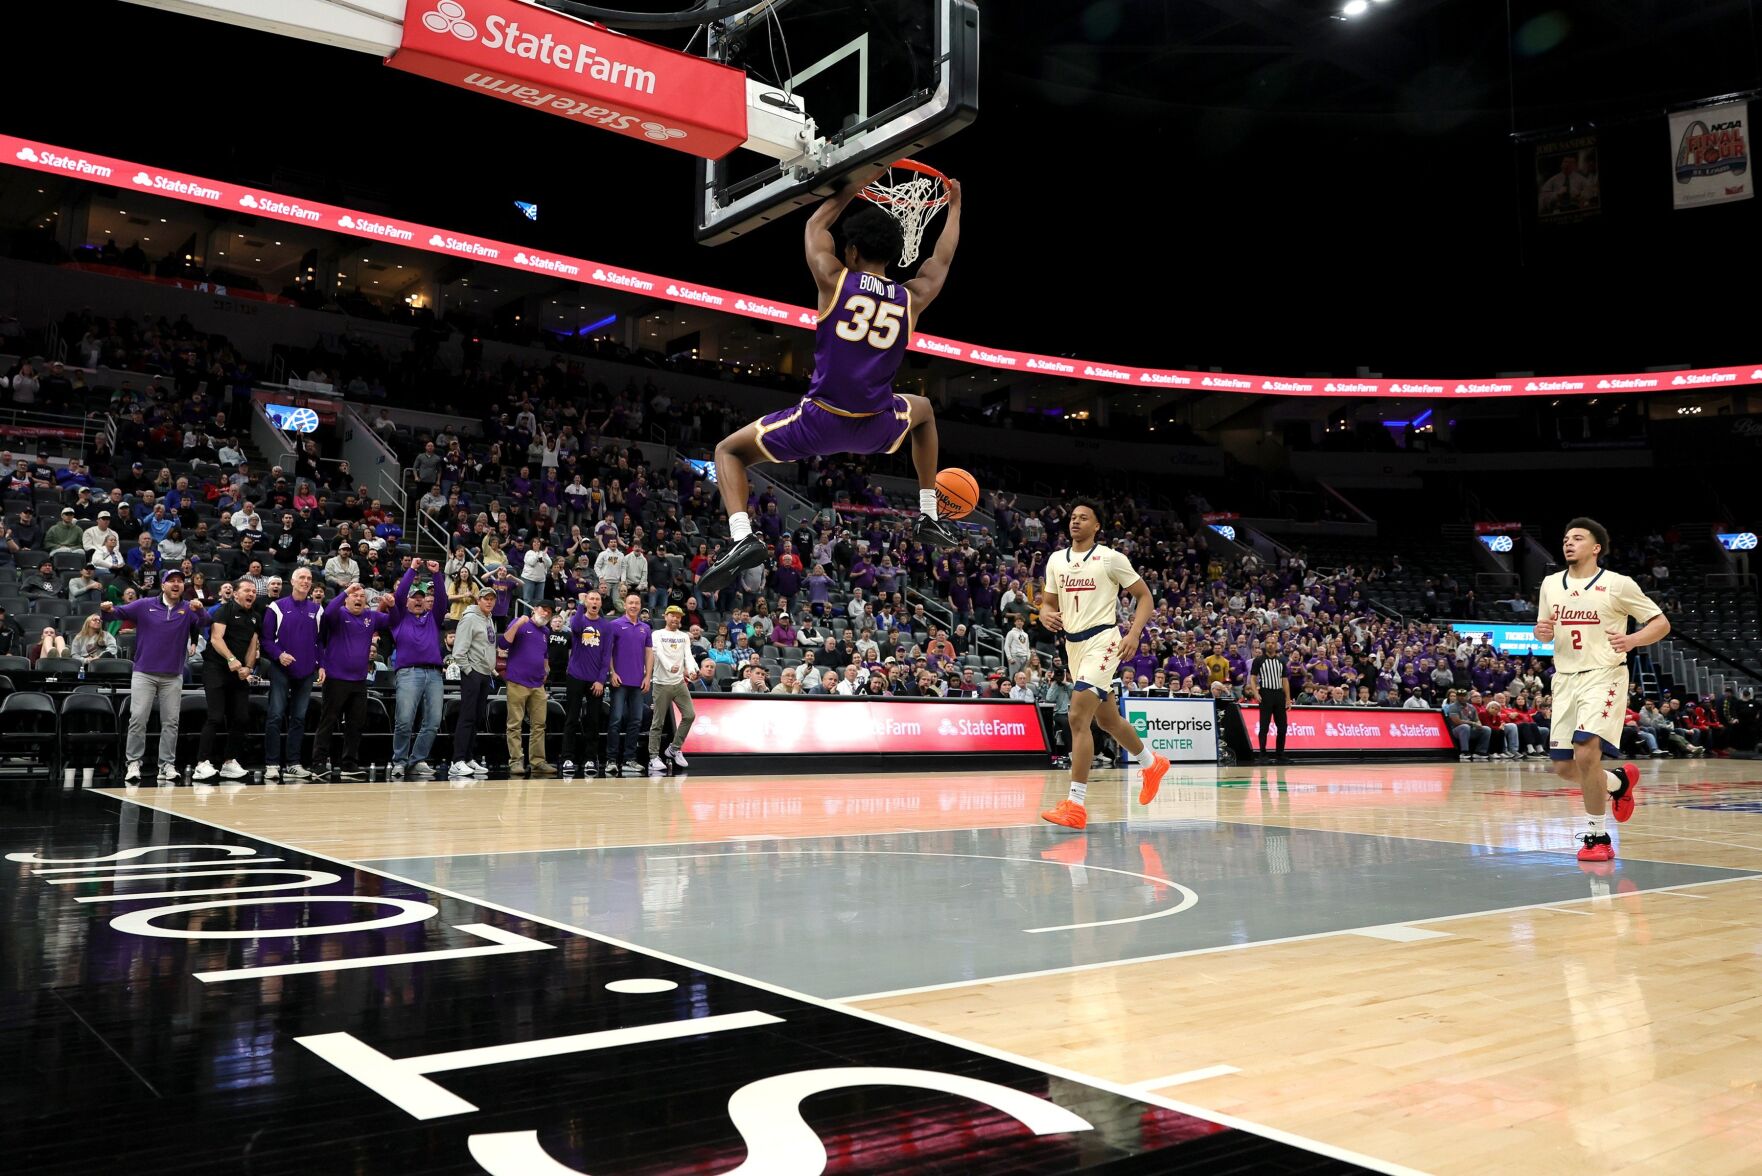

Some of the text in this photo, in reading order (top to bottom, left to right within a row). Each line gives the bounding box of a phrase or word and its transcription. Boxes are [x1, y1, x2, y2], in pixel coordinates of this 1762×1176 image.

[1710, 120, 1742, 132] NCAA
[1687, 129, 1741, 152] FINAL
[859, 274, 895, 299] BOND III
[835, 295, 905, 350] 35
[1059, 574, 1095, 589] Flames
[1073, 595, 1079, 613] 1
[1552, 604, 1599, 622] Flames
[1571, 629, 1583, 650] 2
[1132, 716, 1212, 735] enterprise
[1151, 738, 1193, 750] CENTER
